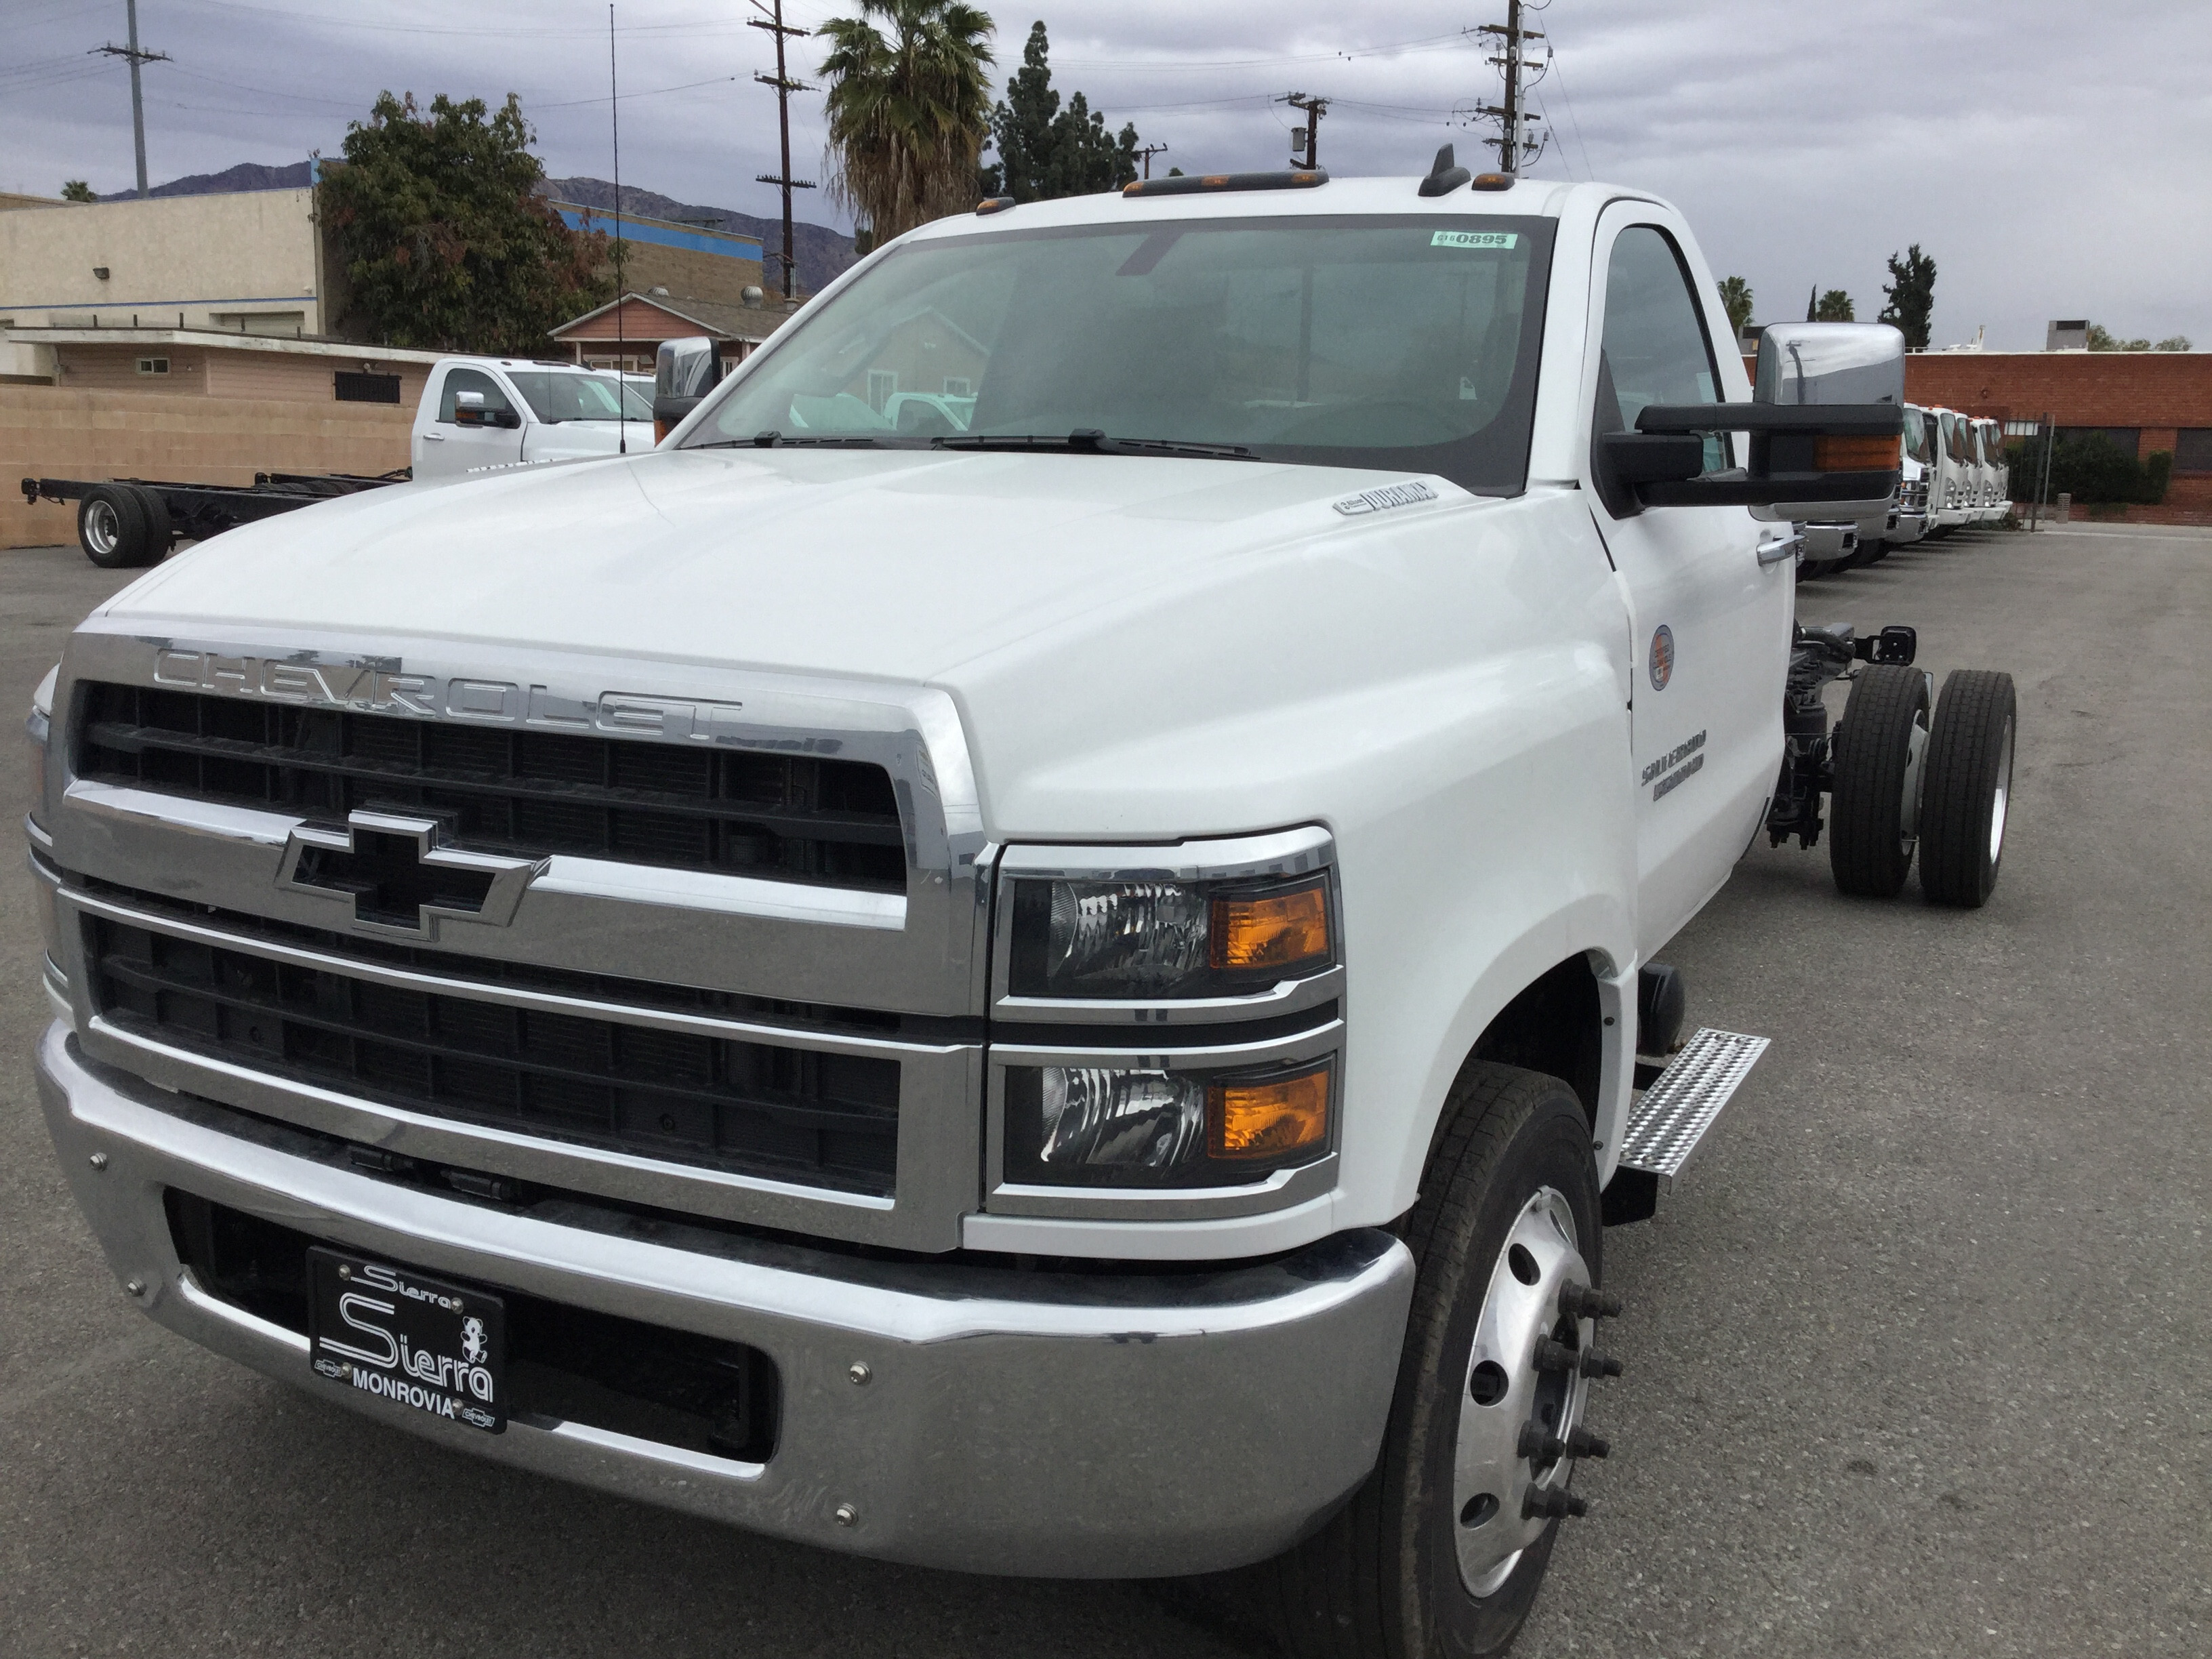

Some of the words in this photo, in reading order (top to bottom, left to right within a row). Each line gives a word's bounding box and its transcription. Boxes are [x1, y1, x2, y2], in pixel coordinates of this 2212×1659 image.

[154, 647, 743, 741] CHEVROLET
[350, 1265, 452, 1309] Sierra
[319, 1292, 493, 1402] Sierra
[352, 1368, 455, 1419] MONROVIA
